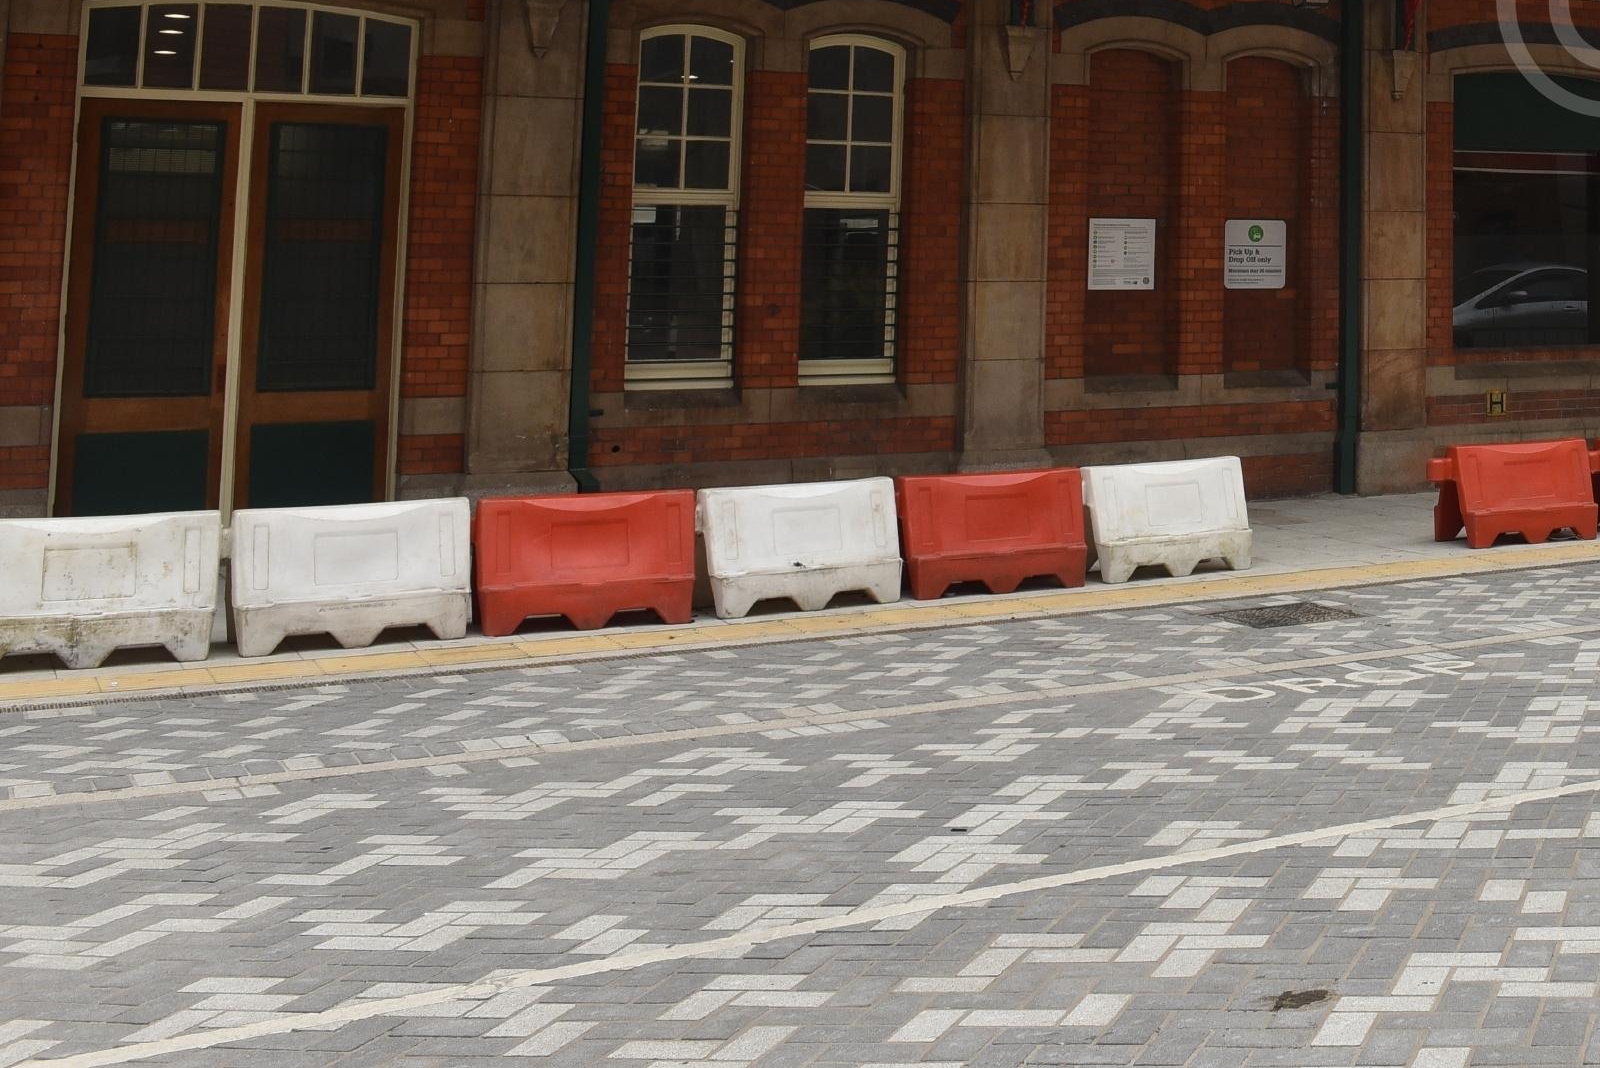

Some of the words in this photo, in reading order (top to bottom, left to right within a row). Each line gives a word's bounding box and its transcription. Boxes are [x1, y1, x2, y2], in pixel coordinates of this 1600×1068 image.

[1229, 248, 1243, 256] Pick
[1244, 248, 1254, 256] Up
[1229, 256, 1245, 264] Drop
[1257, 256, 1271, 264] only
[1490, 392, 1504, 414] H
